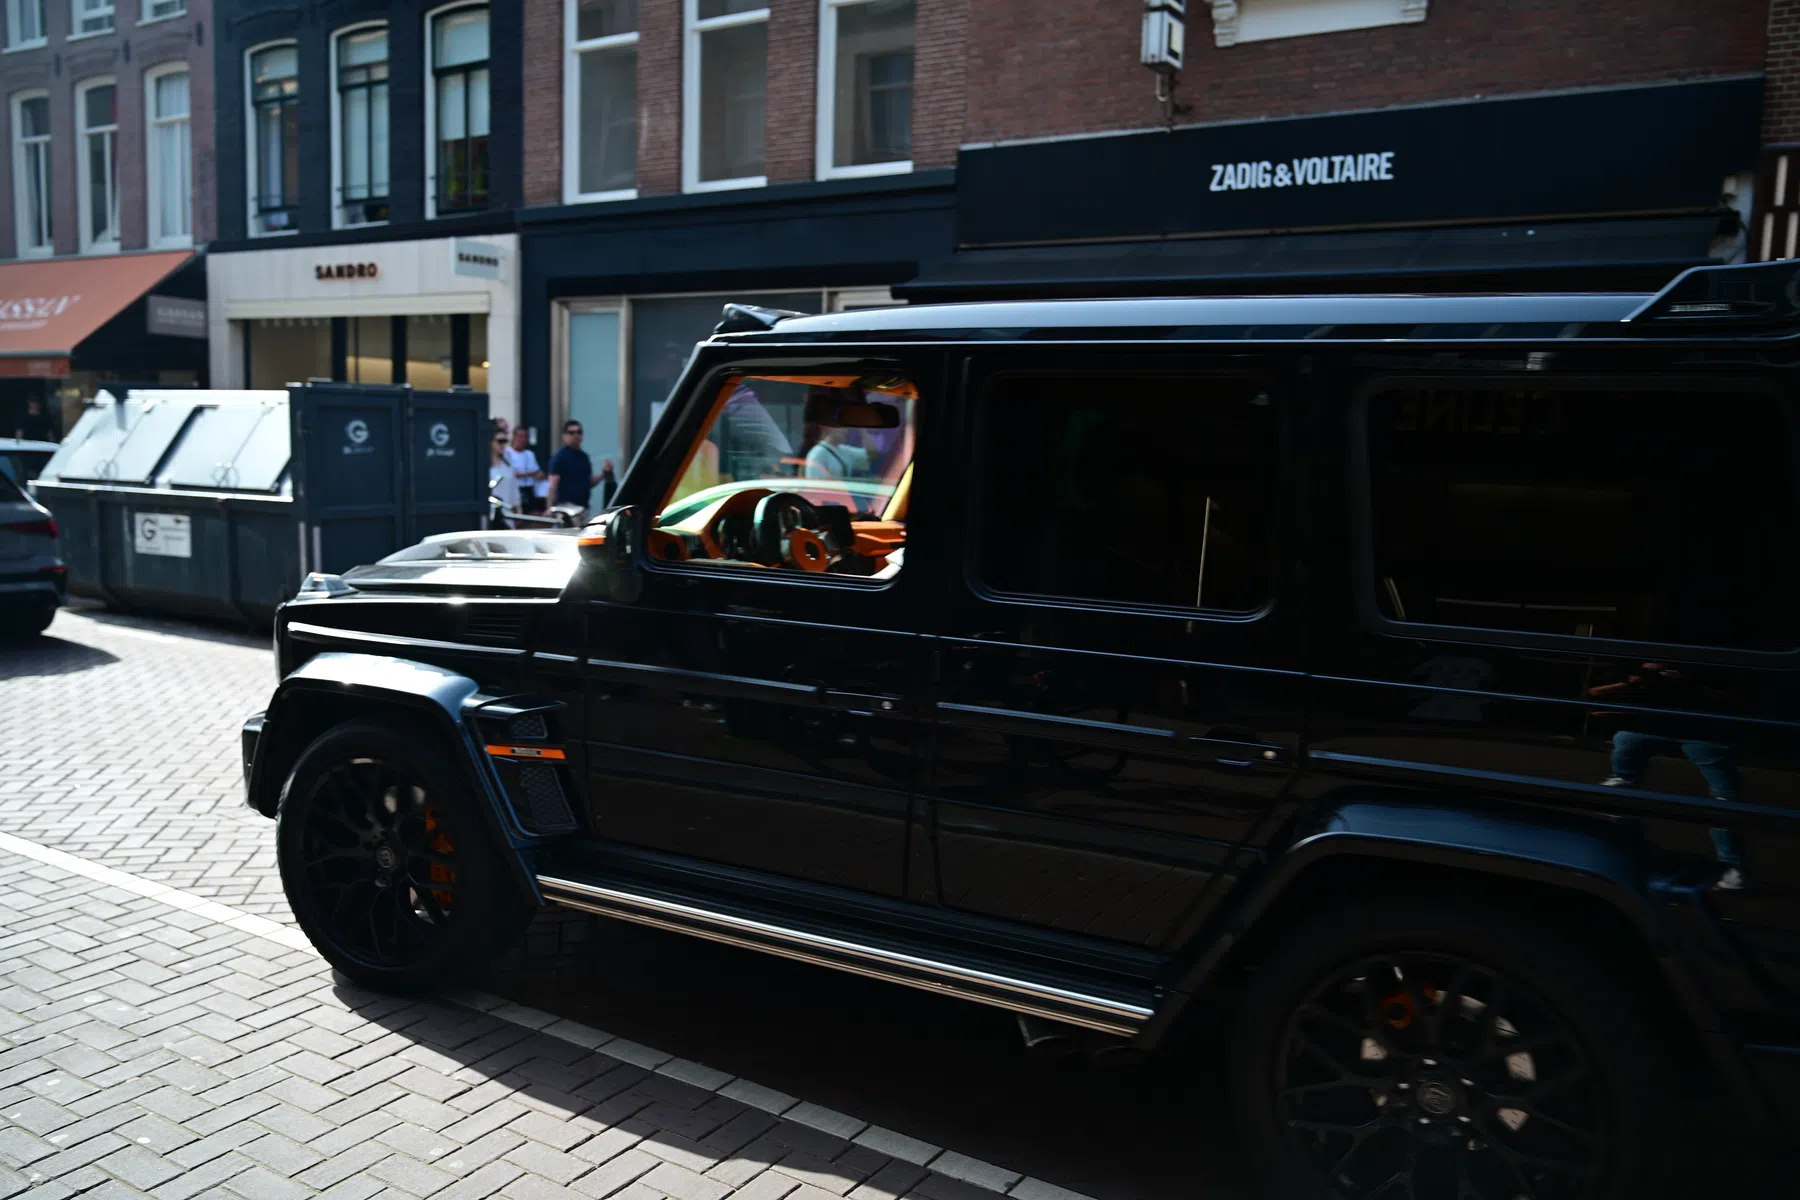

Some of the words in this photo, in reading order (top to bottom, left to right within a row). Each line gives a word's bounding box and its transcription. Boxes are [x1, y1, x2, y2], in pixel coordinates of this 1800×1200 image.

[1209, 151, 1395, 192] ZADIG&VOLTAIRE
[315, 261, 379, 280] SANDRO
[457, 252, 499, 268] SANDRO
[430, 423, 450, 446] G
